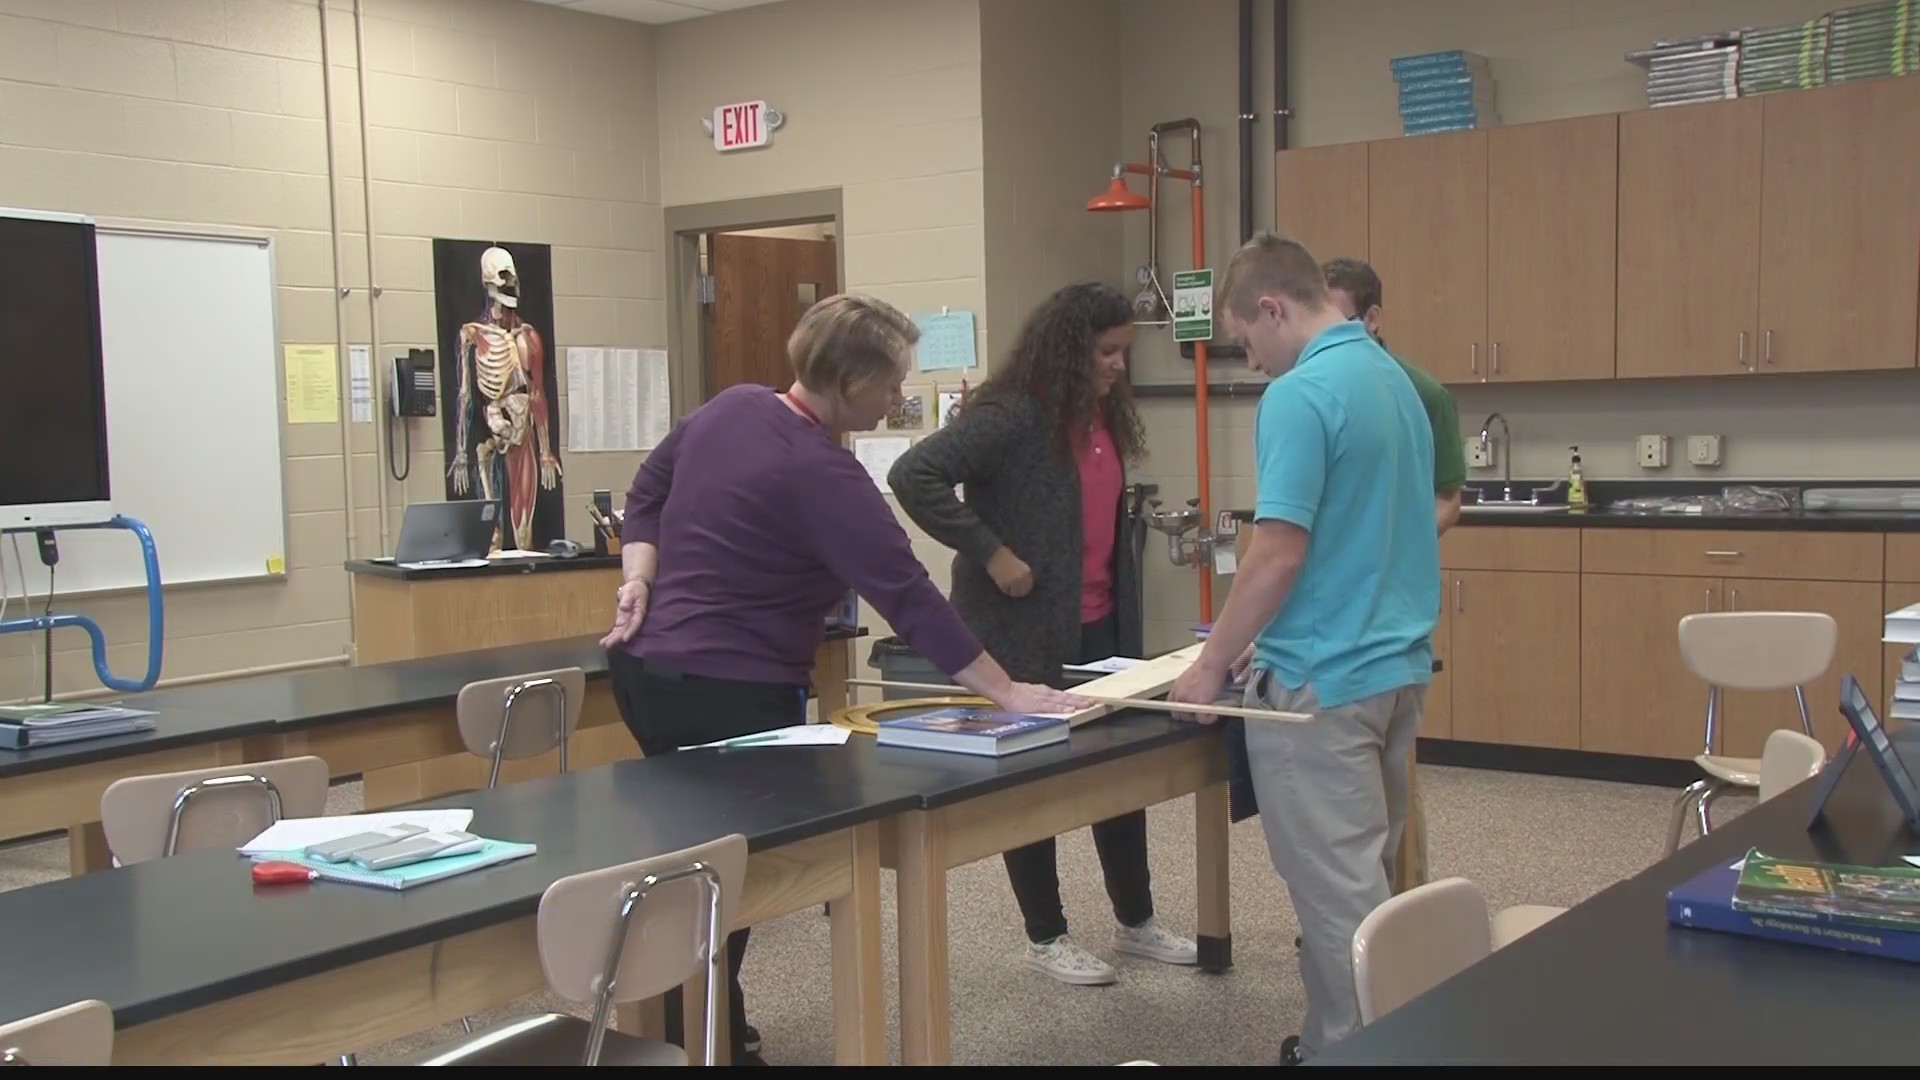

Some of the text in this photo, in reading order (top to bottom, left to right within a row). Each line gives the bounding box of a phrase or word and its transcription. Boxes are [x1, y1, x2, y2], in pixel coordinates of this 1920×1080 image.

[1398, 56, 1437, 67] CHEMISTRY
[1402, 68, 1440, 78] CHEMISTRY
[723, 104, 759, 146] EXIT
[1765, 917, 1810, 935] Sociology
[1811, 926, 1822, 936] to
[1823, 929, 1882, 946] Introduction
